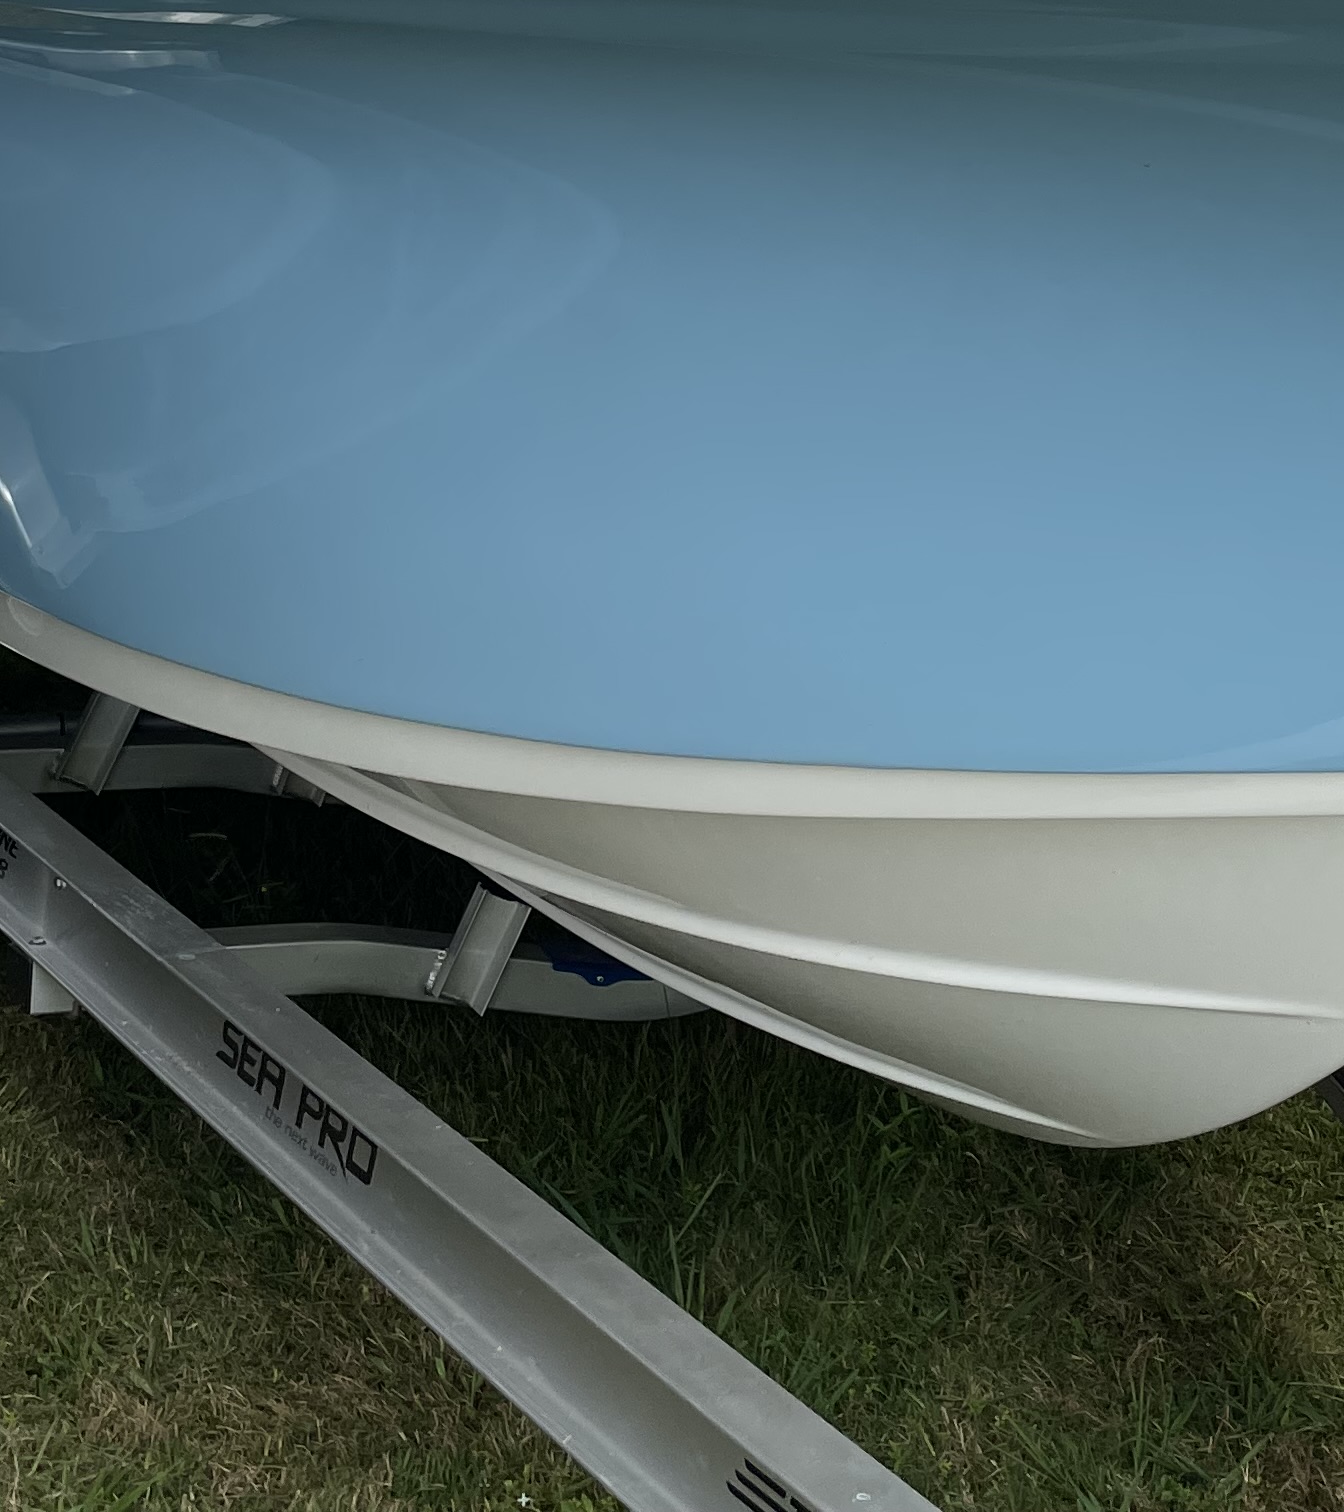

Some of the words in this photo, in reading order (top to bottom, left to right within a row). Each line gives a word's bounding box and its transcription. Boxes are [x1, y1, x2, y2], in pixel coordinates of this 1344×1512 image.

[216, 1020, 286, 1110] SEA
[295, 1084, 378, 1185] PRO
[265, 1106, 283, 1129] the
[285, 1127, 307, 1150] next
[309, 1146, 338, 1176] wave
